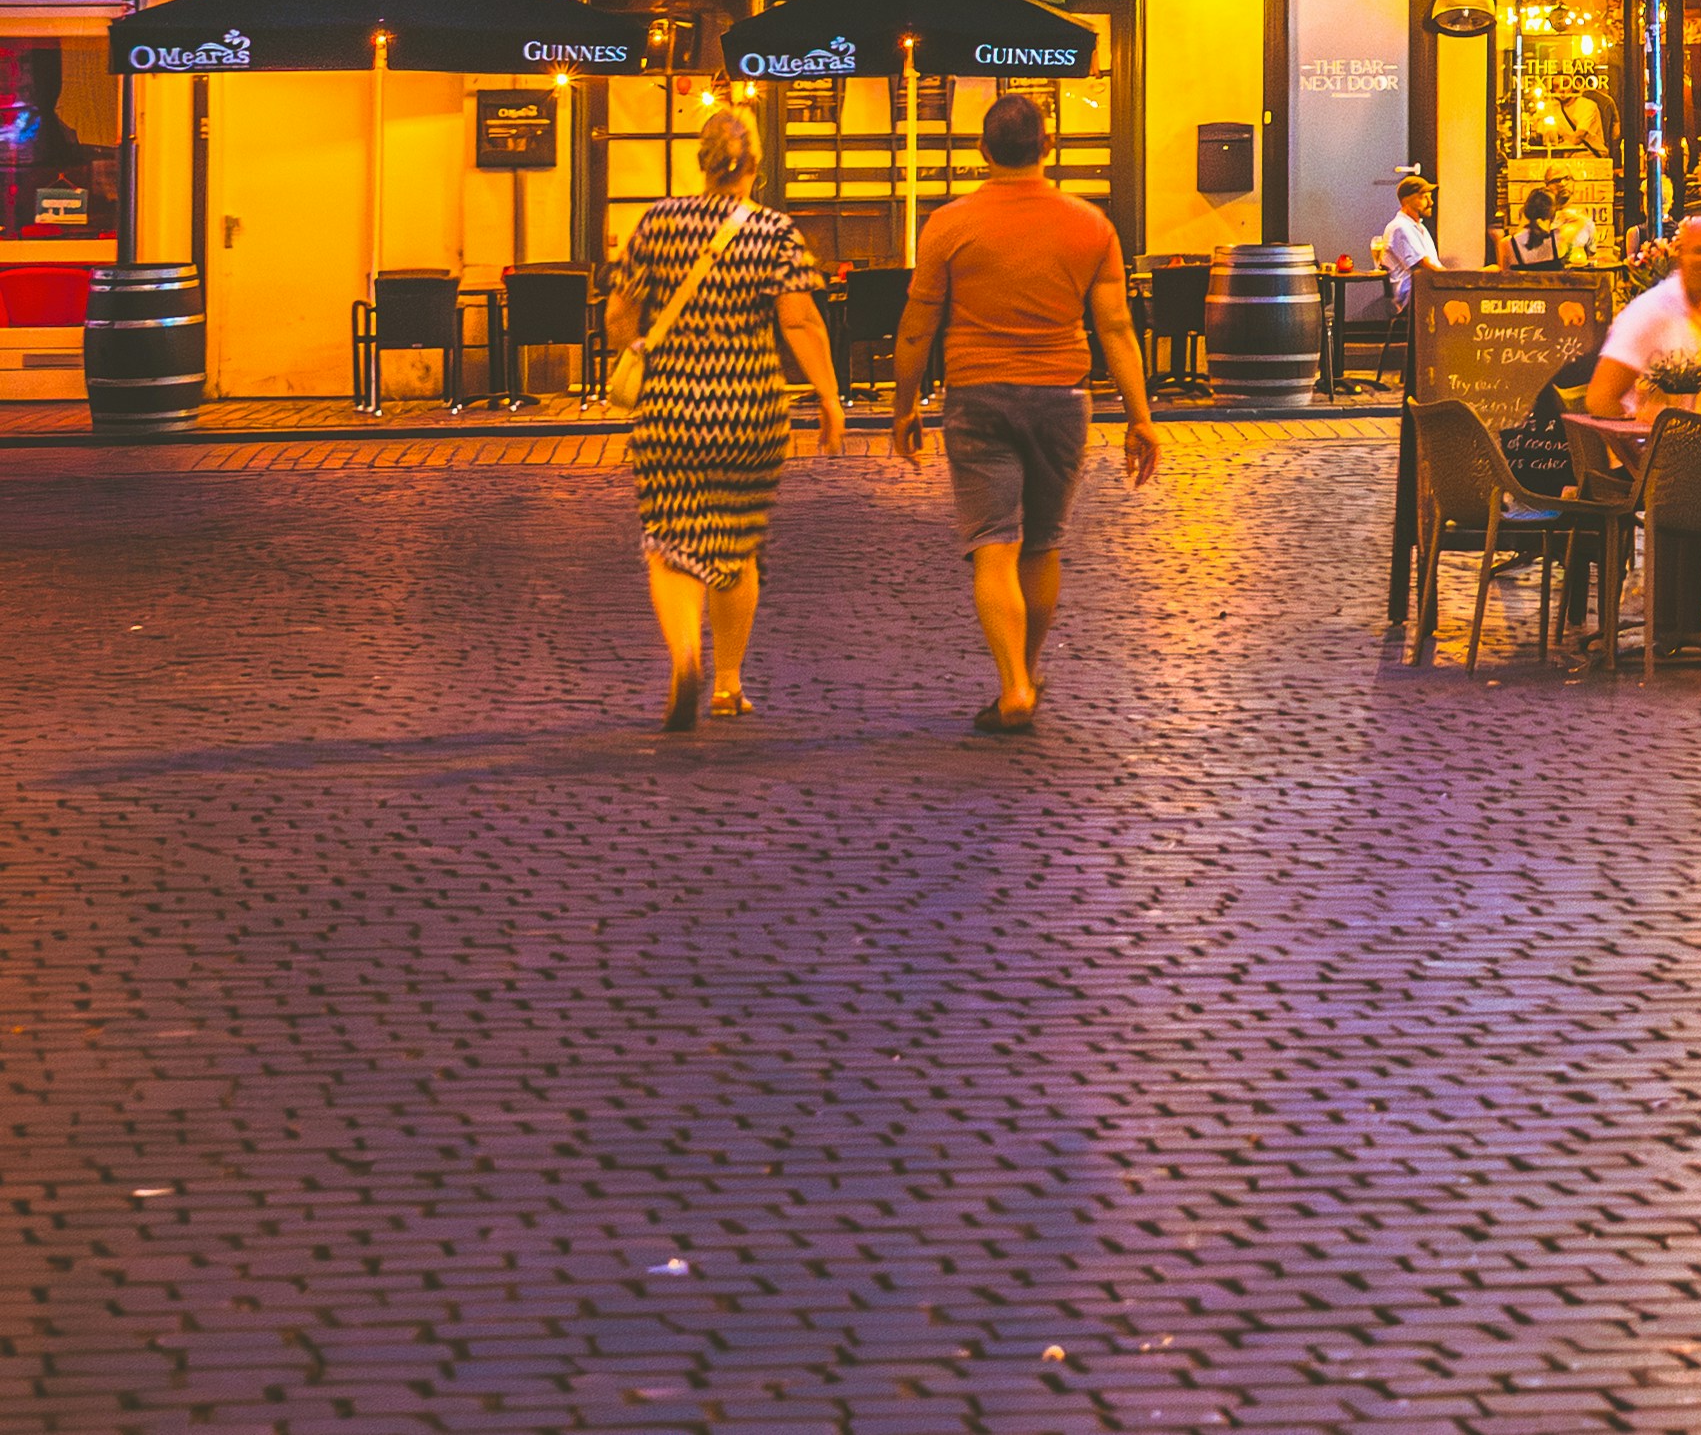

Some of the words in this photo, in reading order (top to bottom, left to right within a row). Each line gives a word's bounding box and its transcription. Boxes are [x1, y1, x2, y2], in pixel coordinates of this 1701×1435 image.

[523, 41, 628, 63] GUINNESS
[975, 44, 1078, 66] GUINNESS
[1313, 59, 1347, 75] THE
[1350, 59, 1385, 75] BAR
[1525, 59, 1558, 75] THE
[1561, 59, 1594, 75] BAR
[1300, 75, 1343, 91] NEXT
[1347, 75, 1399, 91] DOOR
[1512, 75, 1555, 91] NEXT
[1559, 75, 1609, 91] DOOR
[1481, 299, 1547, 315] DELIRIUM
[1473, 323, 1548, 345] SUMMER
[1501, 348, 1551, 365] BACK
